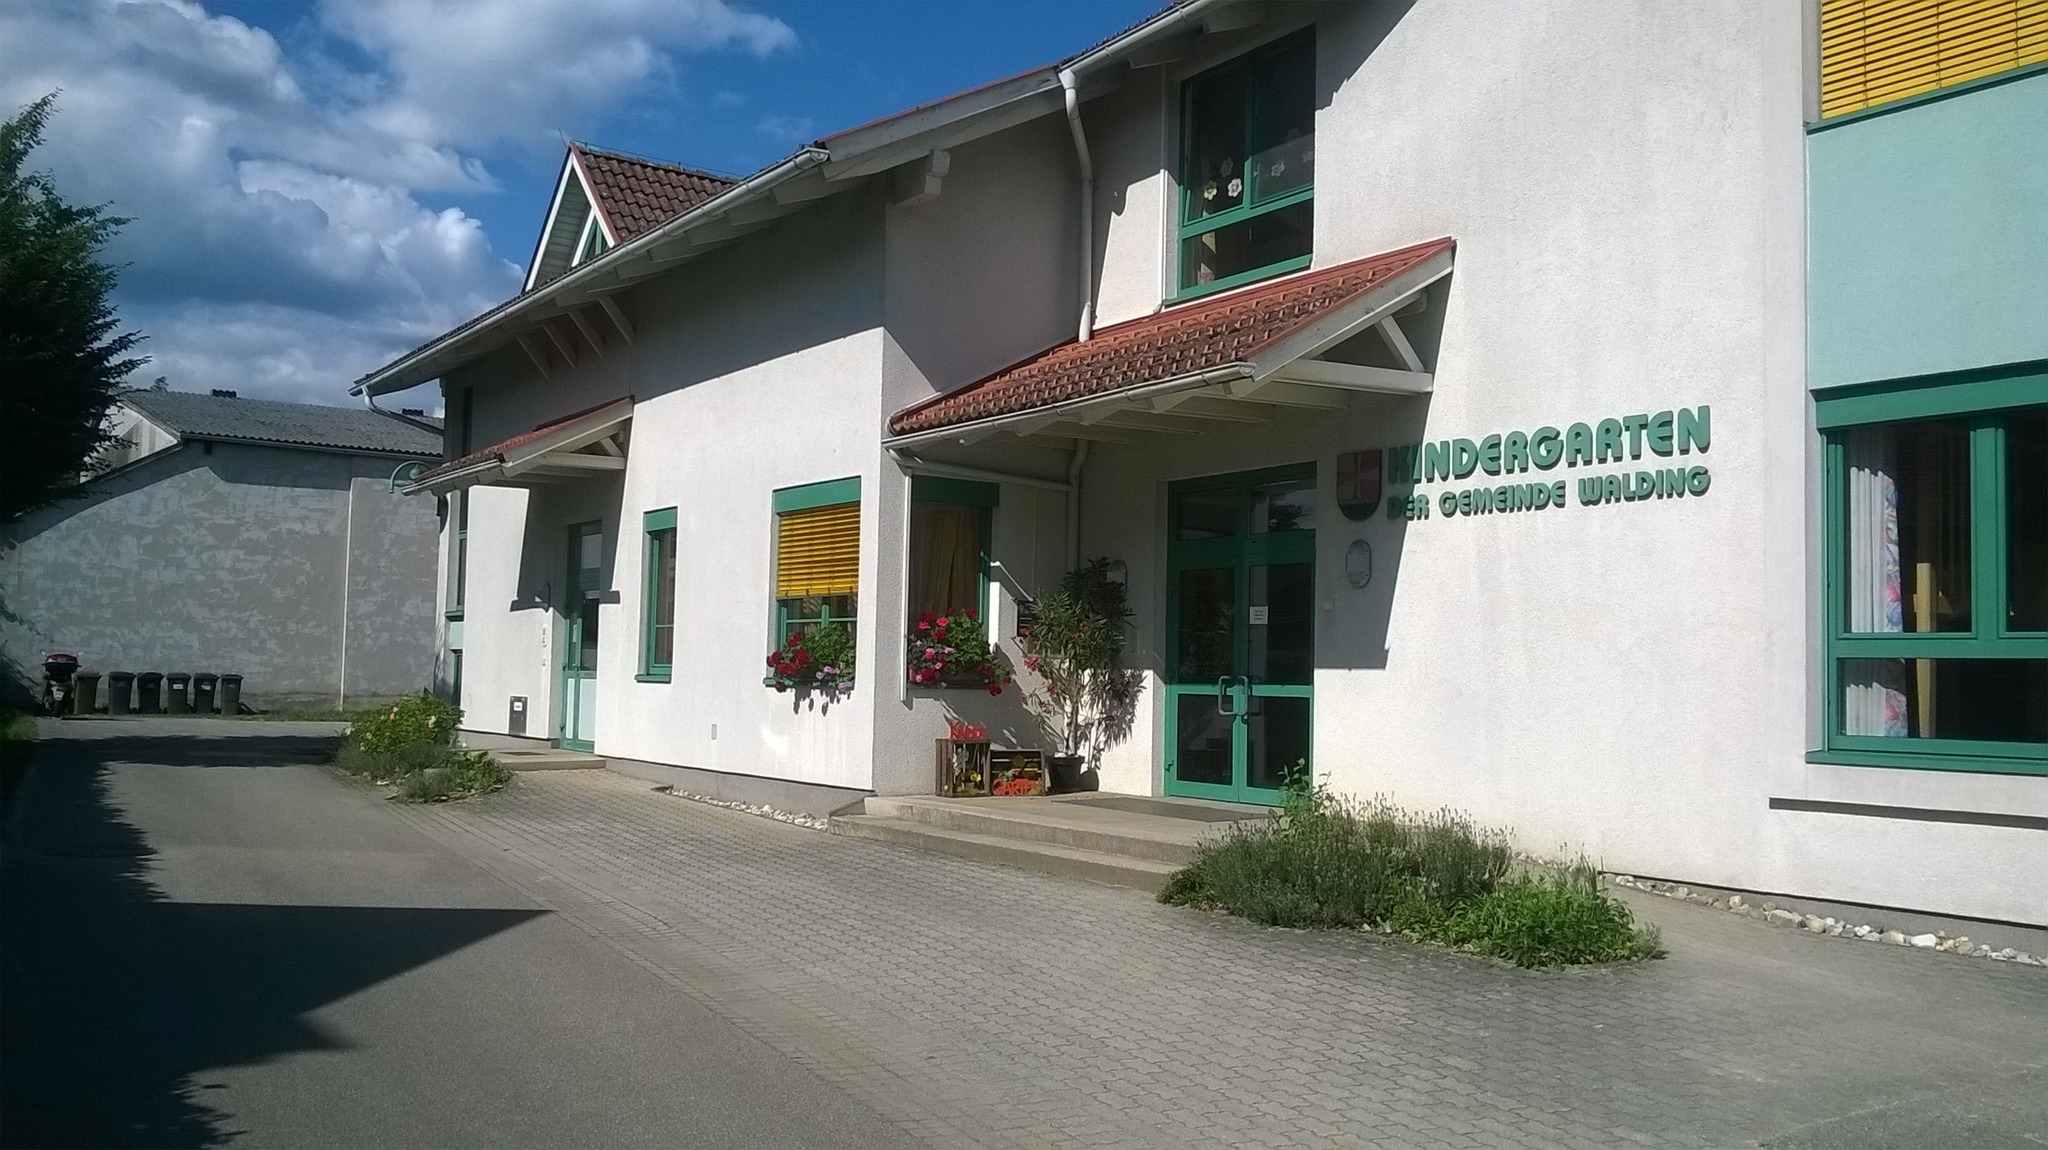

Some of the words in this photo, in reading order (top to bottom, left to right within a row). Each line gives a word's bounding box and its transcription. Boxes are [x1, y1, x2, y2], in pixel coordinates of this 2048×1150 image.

[1387, 405, 1711, 484] KINDERGARTEN
[1387, 494, 1430, 520] DER
[1439, 481, 1566, 518] GEMEINDE
[1578, 465, 1711, 506] WALDING
